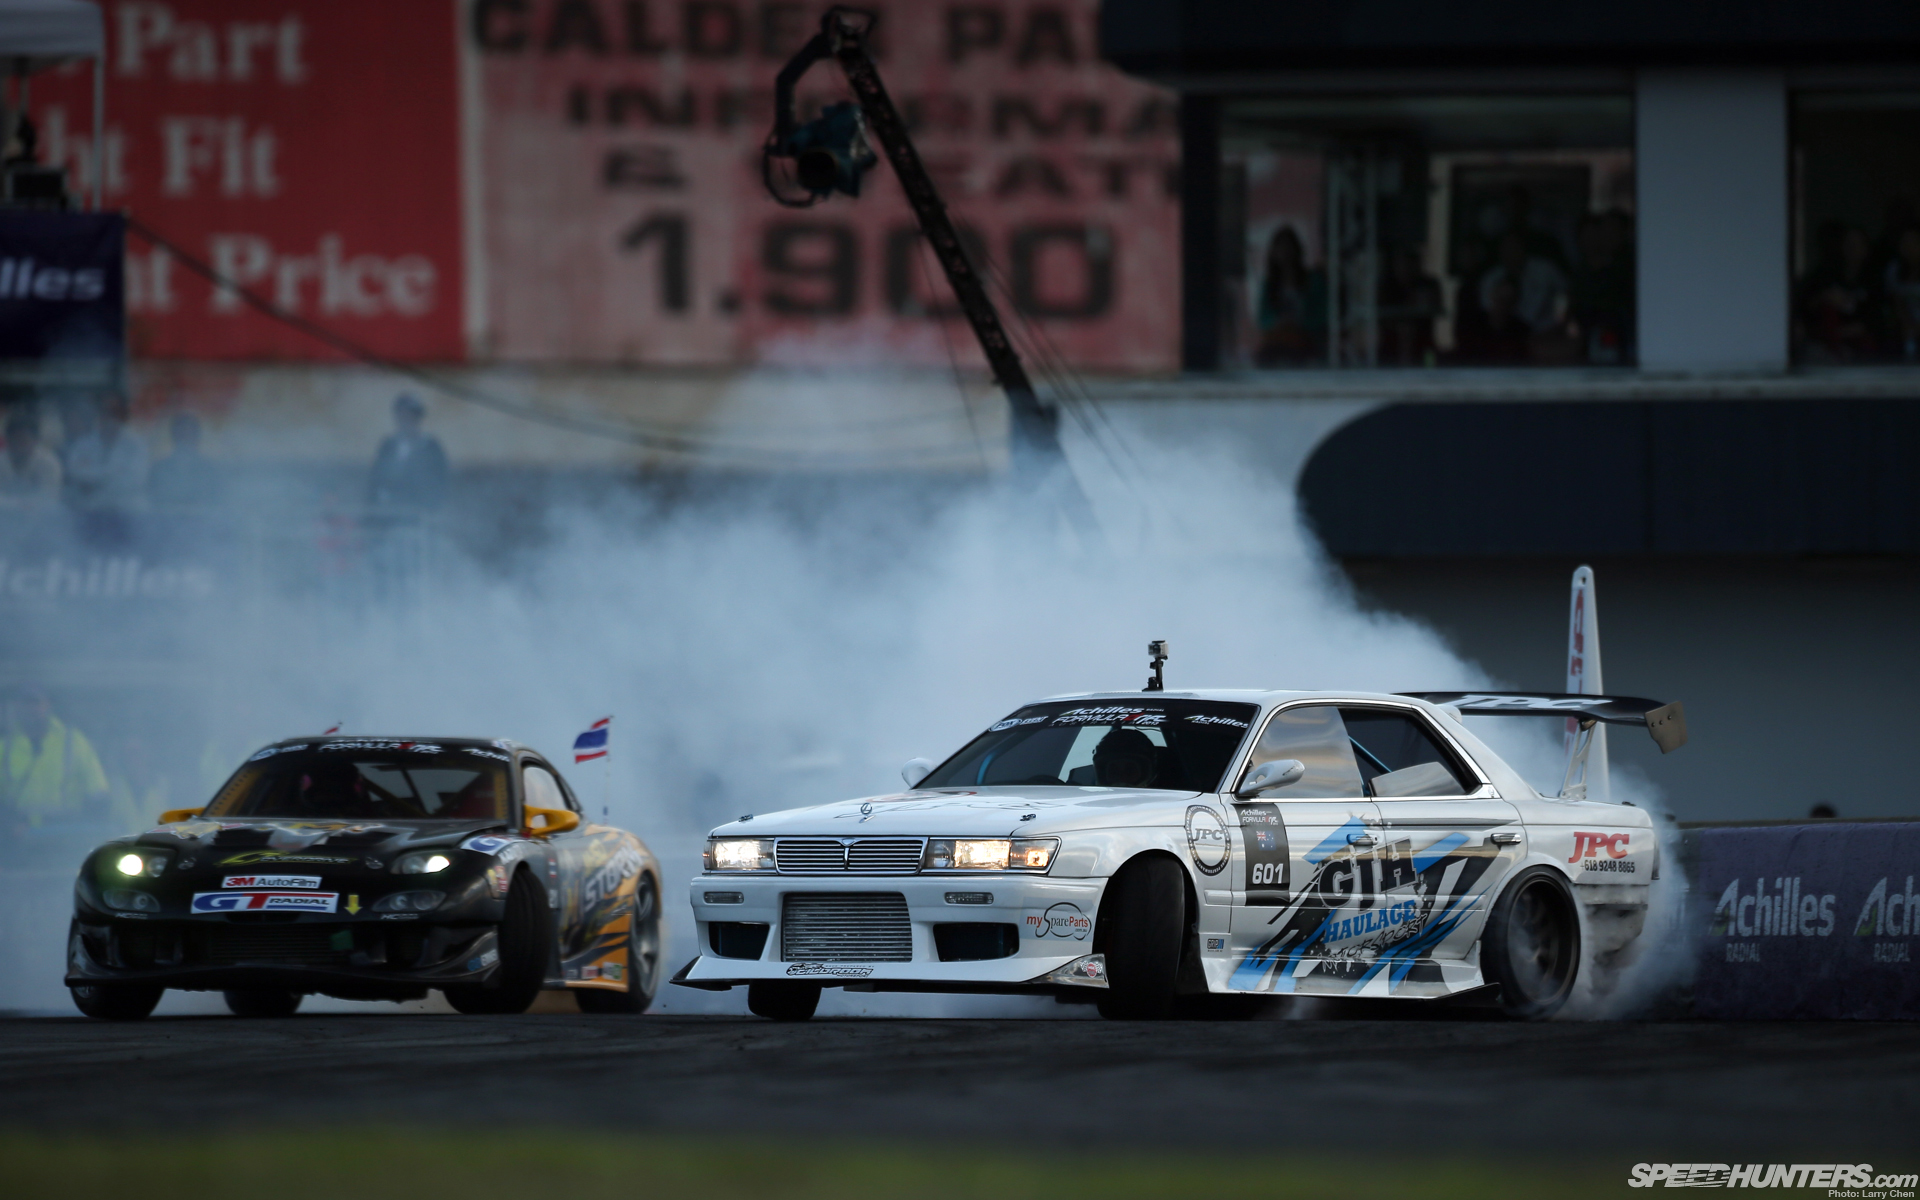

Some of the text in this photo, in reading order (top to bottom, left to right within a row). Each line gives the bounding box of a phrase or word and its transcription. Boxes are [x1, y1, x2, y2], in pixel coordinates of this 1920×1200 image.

[114, 4, 308, 84] Part
[162, 115, 280, 198] Fit
[208, 232, 436, 316] Price
[618, 211, 1116, 318] 1.900
[1191, 828, 1226, 842] JPC
[1567, 831, 1630, 863] JPC
[226, 876, 319, 888] 3M AutoFilm
[1251, 862, 1285, 885] 601
[268, 897, 331, 906] RADIAL
[1709, 877, 1836, 938] Achilles
[1323, 899, 1416, 944] HAULAGE
[1725, 942, 1761, 963] RADIAL
[1873, 942, 1911, 963] RADIAL
